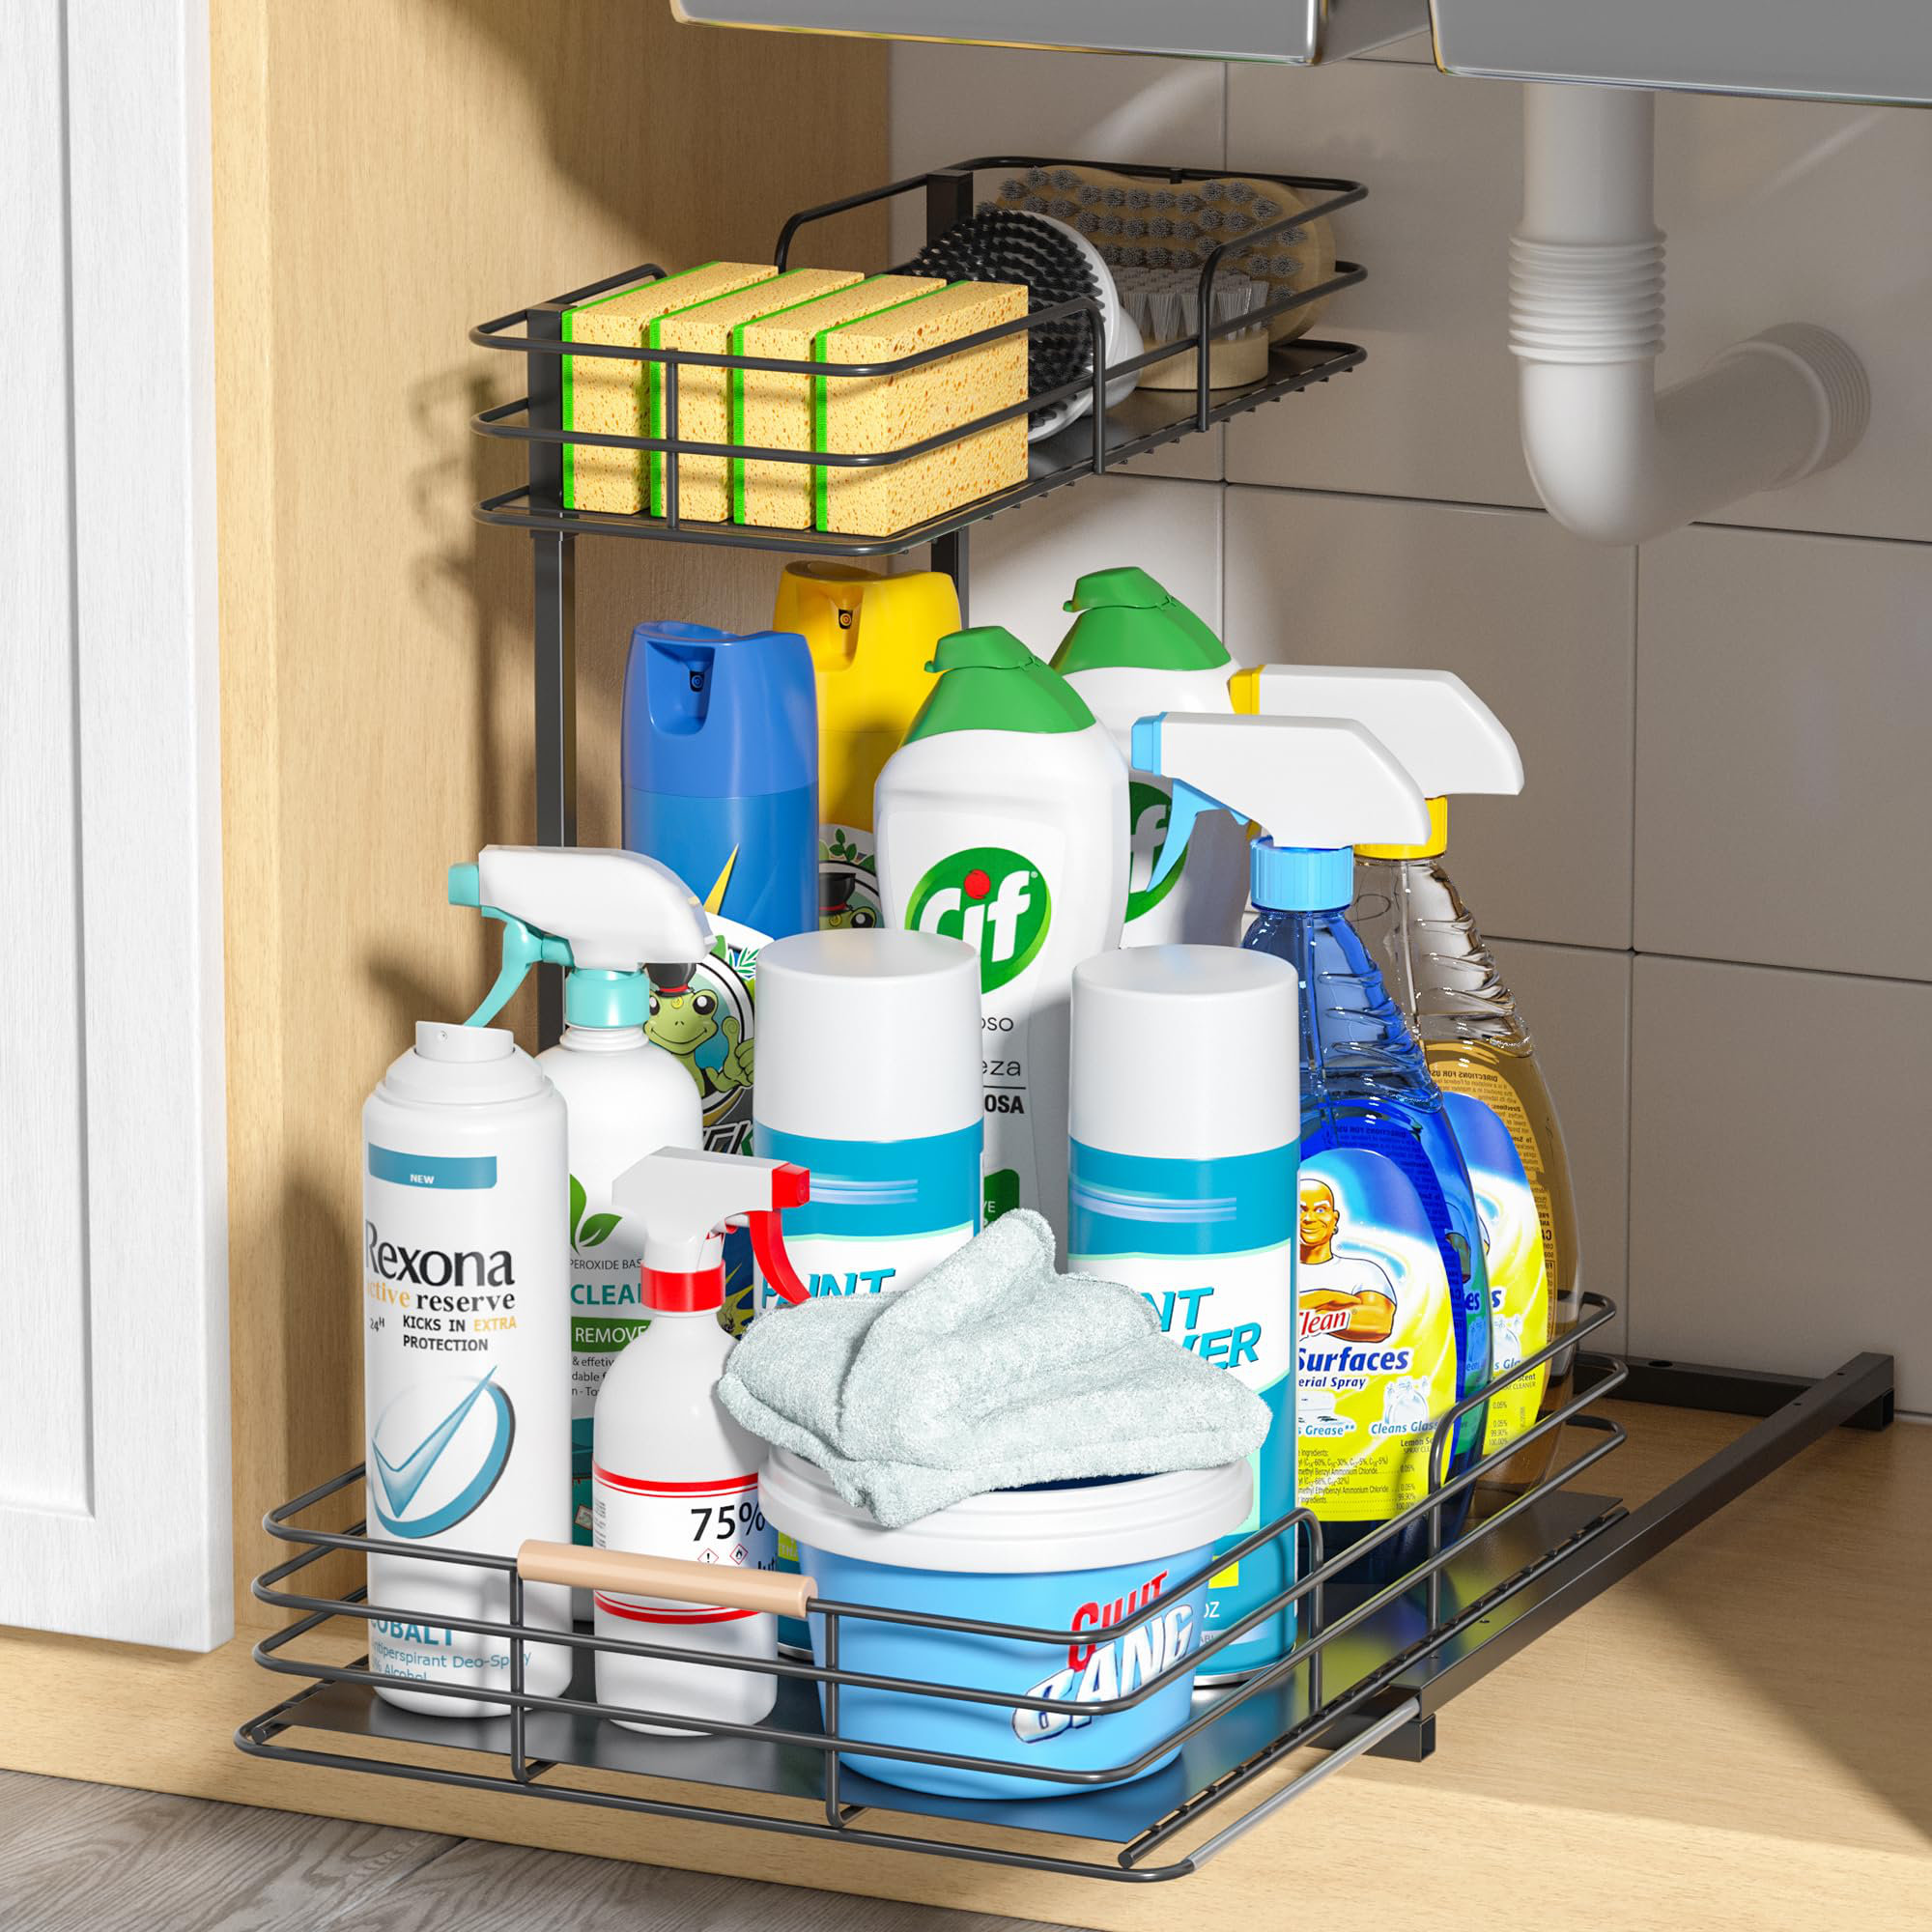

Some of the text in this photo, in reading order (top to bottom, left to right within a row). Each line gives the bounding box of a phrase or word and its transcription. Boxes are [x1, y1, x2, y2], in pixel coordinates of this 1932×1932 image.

[410, 1174, 435, 1184] NEW
[366, 1219, 516, 1287] Rexona
[417, 1293, 516, 1312] reserve
[403, 1315, 517, 1332] KICKS IN EXTRA
[1298, 1311, 1347, 1336] lean
[403, 1335, 489, 1351] PROTECTION
[1330, 1376, 1366, 1390] Spray
[1371, 1424, 1407, 1435] Cleans
[1401, 1438, 1424, 1447] Lemon
[691, 1502, 766, 1543] 75%
